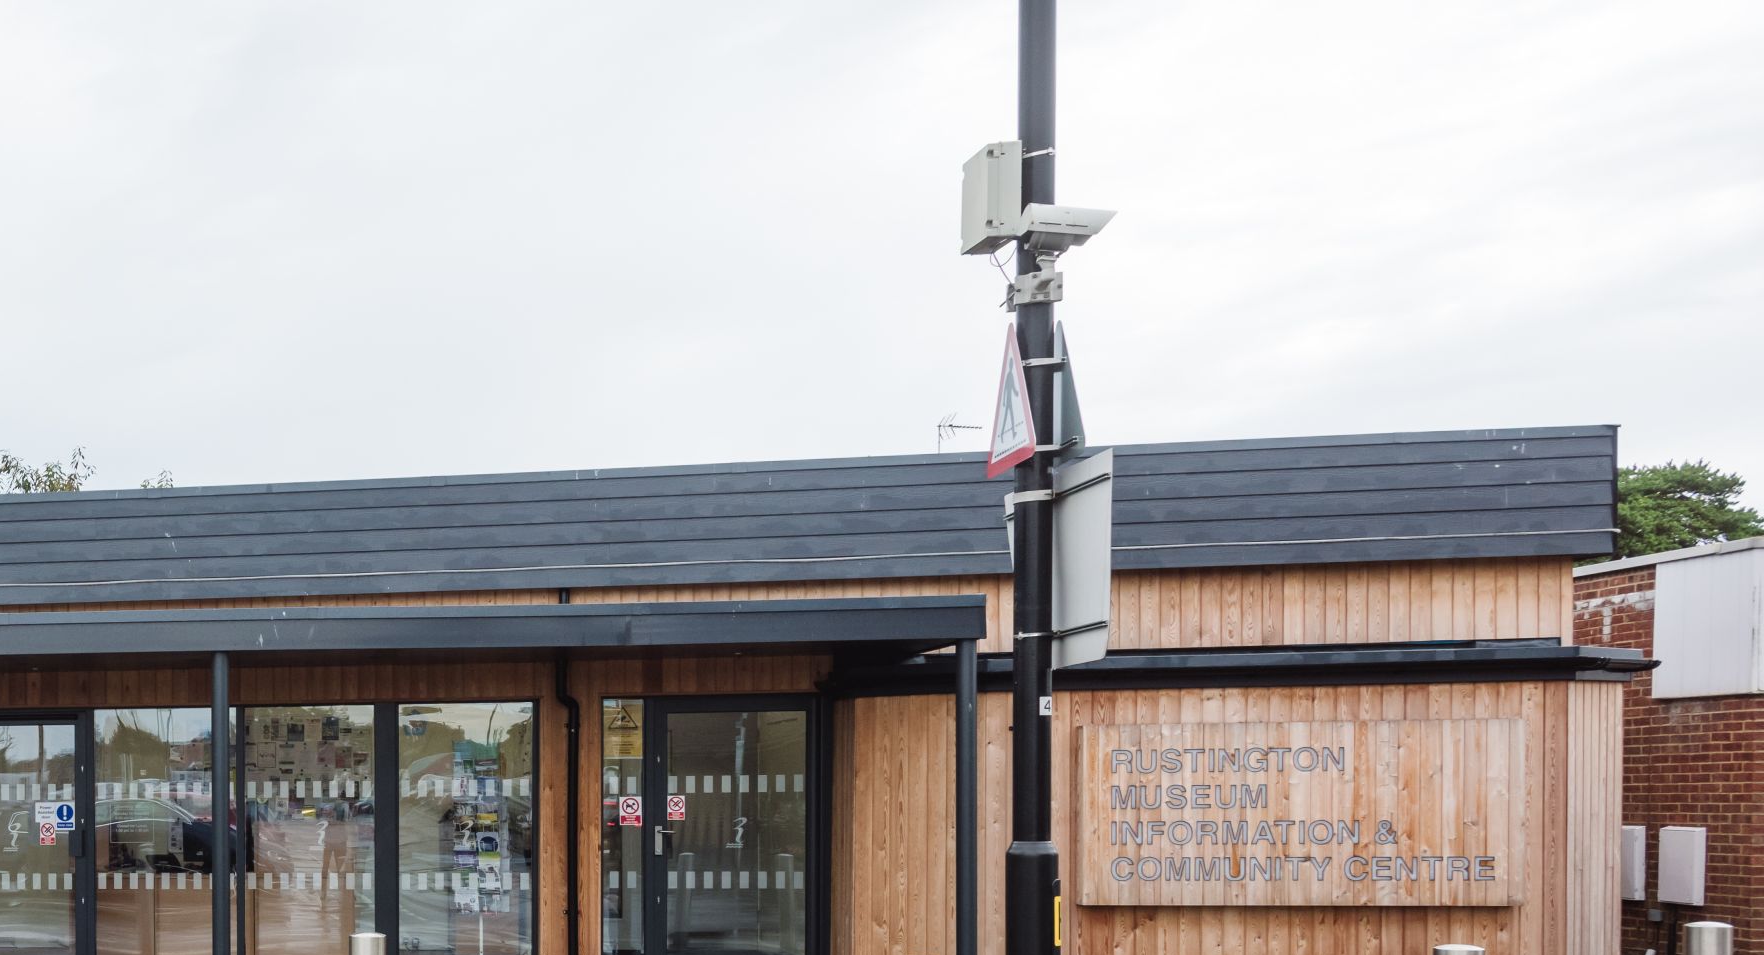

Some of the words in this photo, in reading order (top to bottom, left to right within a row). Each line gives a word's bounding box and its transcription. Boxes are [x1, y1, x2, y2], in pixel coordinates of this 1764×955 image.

[1044, 699, 1051, 712] 4
[1110, 746, 1346, 774] RUSTINGTON
[1110, 783, 1269, 810] MUSEUM
[1110, 819, 1361, 846] INFORMATION
[1373, 819, 1399, 846] &
[1110, 855, 1332, 883] COMMUNITY
[1343, 855, 1497, 882] CENTRE
